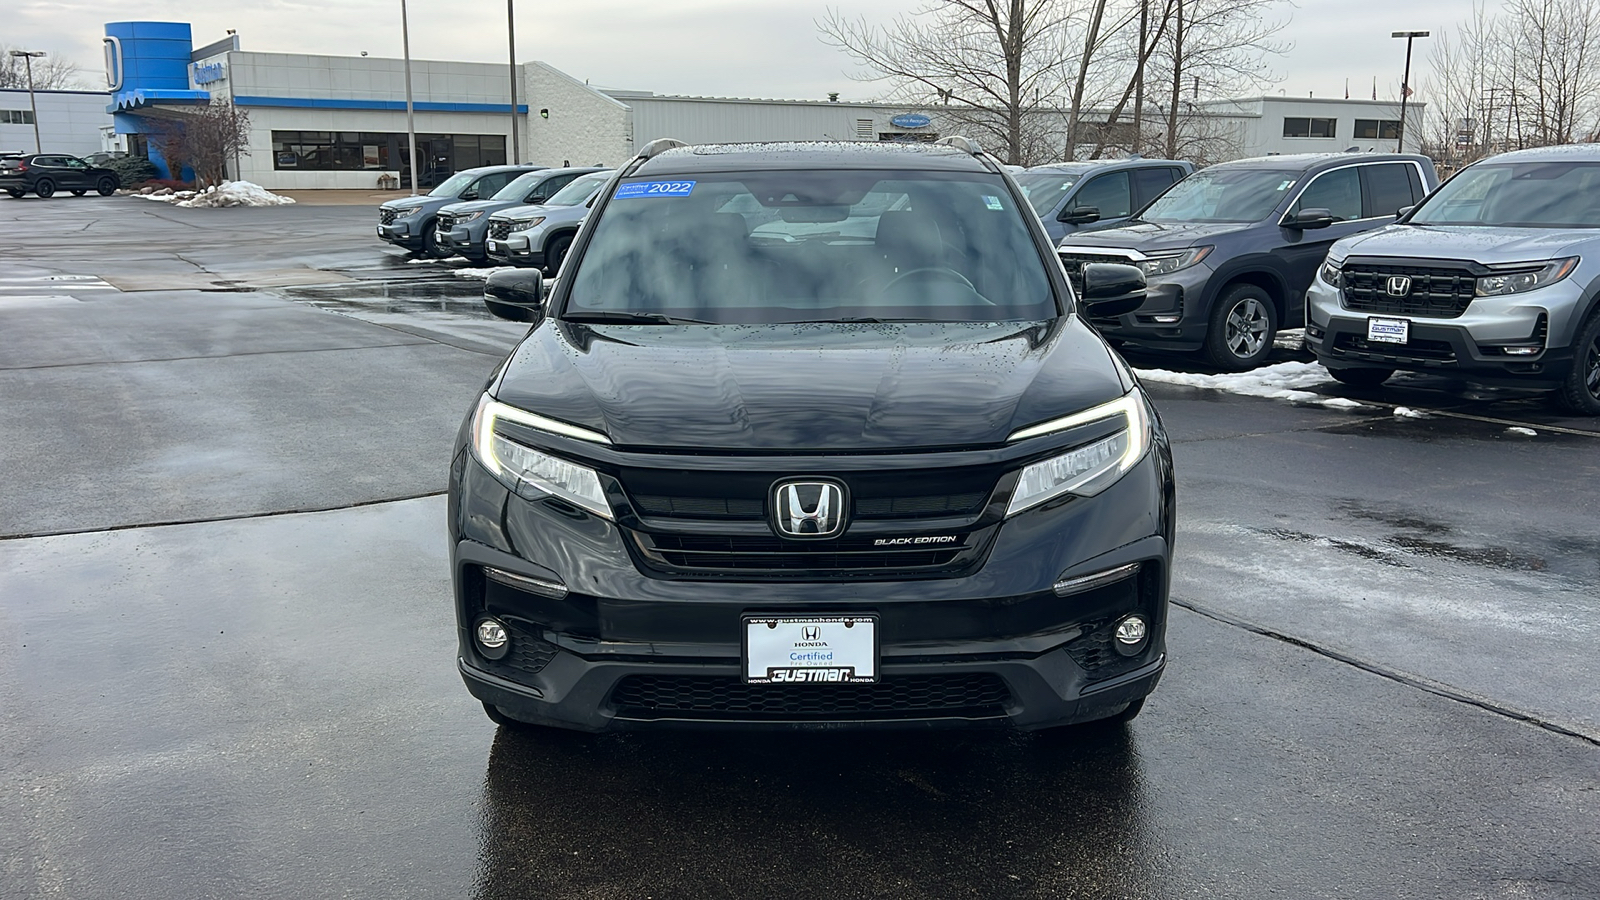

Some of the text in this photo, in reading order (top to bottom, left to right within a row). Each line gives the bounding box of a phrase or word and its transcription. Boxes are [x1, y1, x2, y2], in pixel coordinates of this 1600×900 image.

[648, 183, 692, 193] 2022
[874, 536, 957, 546] BLACK EDITION
[790, 652, 833, 661] Certified
